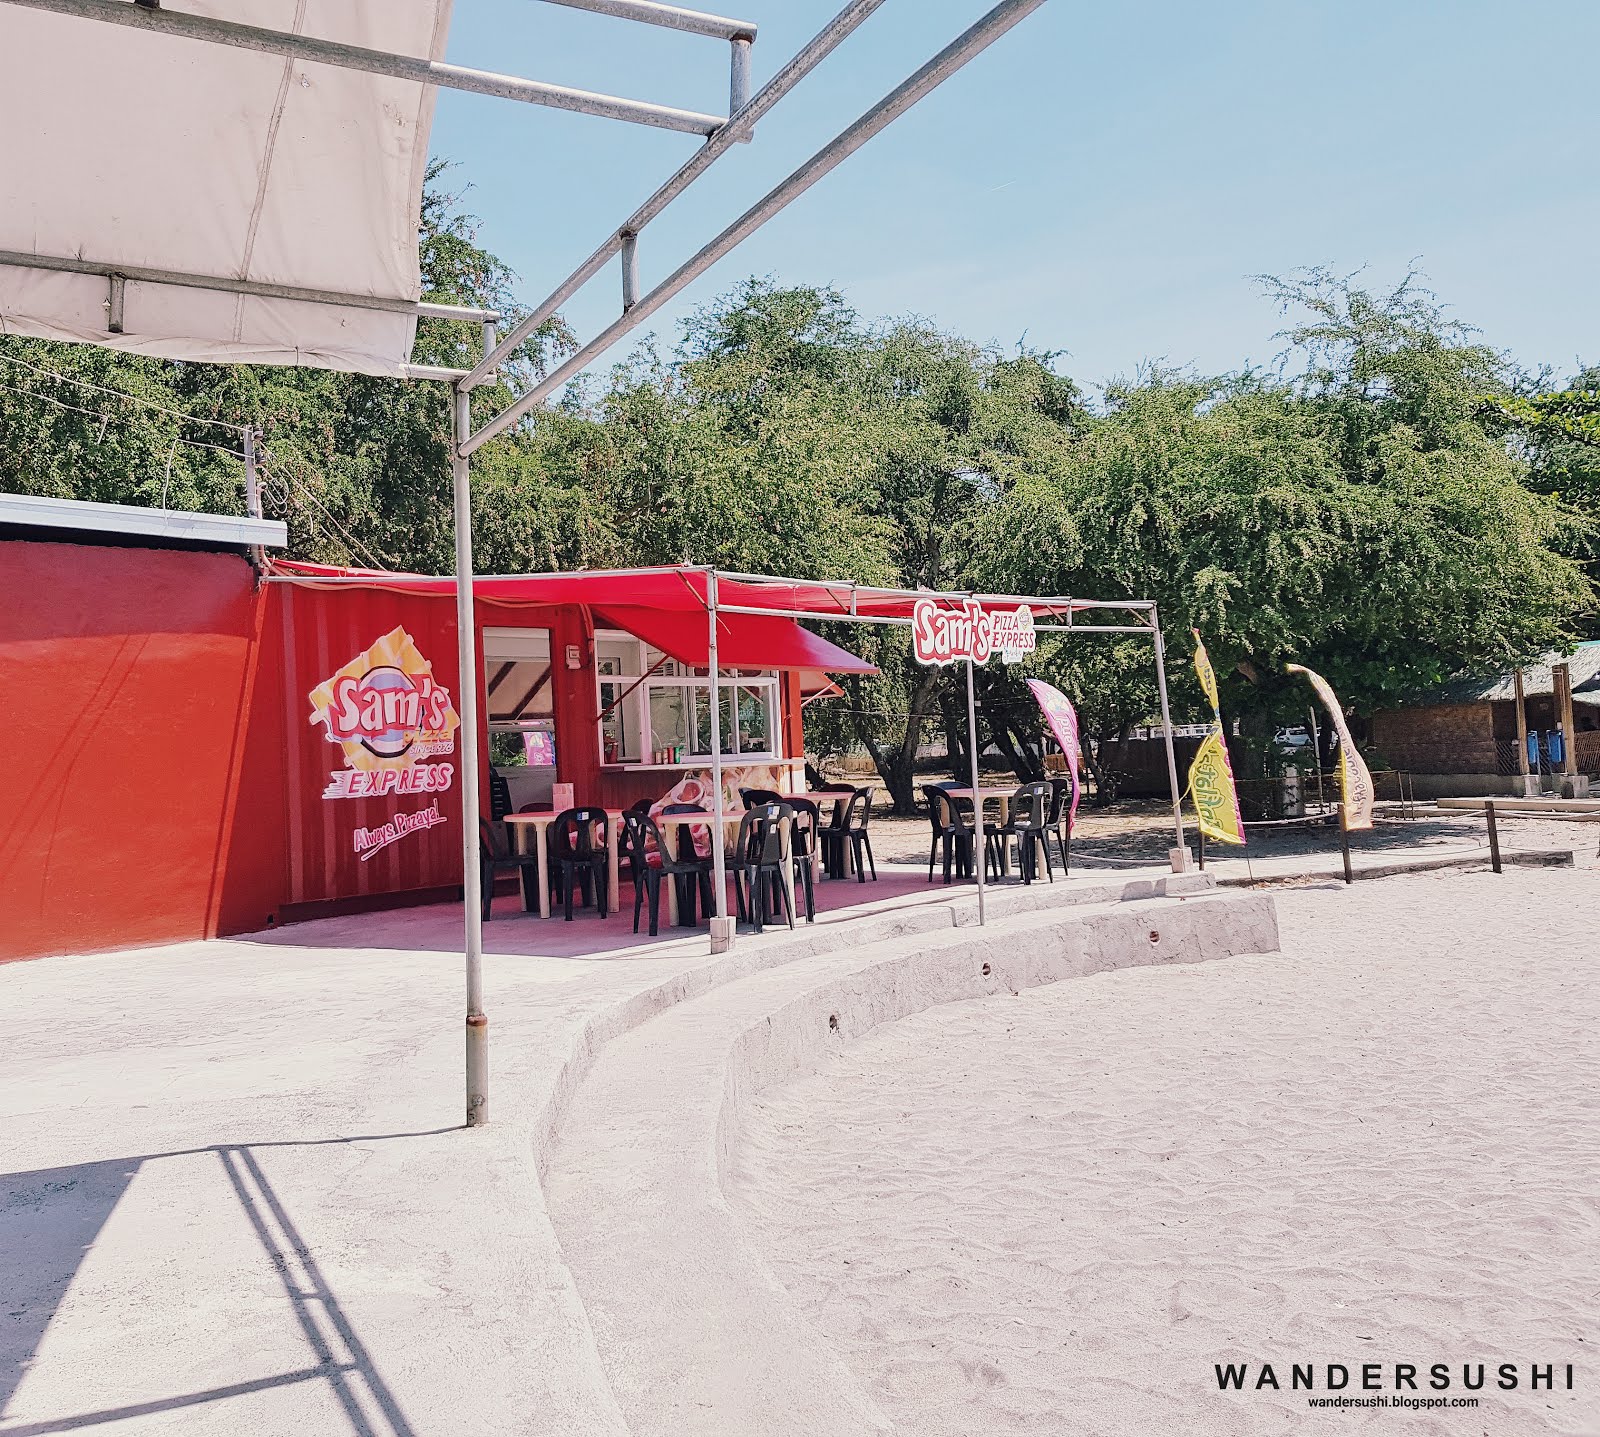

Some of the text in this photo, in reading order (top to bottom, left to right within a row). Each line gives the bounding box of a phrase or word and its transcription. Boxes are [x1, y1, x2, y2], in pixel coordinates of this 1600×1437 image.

[918, 604, 989, 659] Sam's
[993, 614, 1018, 631] PIZZA
[991, 632, 1034, 648] EXPRESS
[337, 676, 447, 732] Sam's
[409, 744, 435, 755] SINCE
[347, 765, 452, 795] EXPRESS
[354, 825, 395, 852] Always
